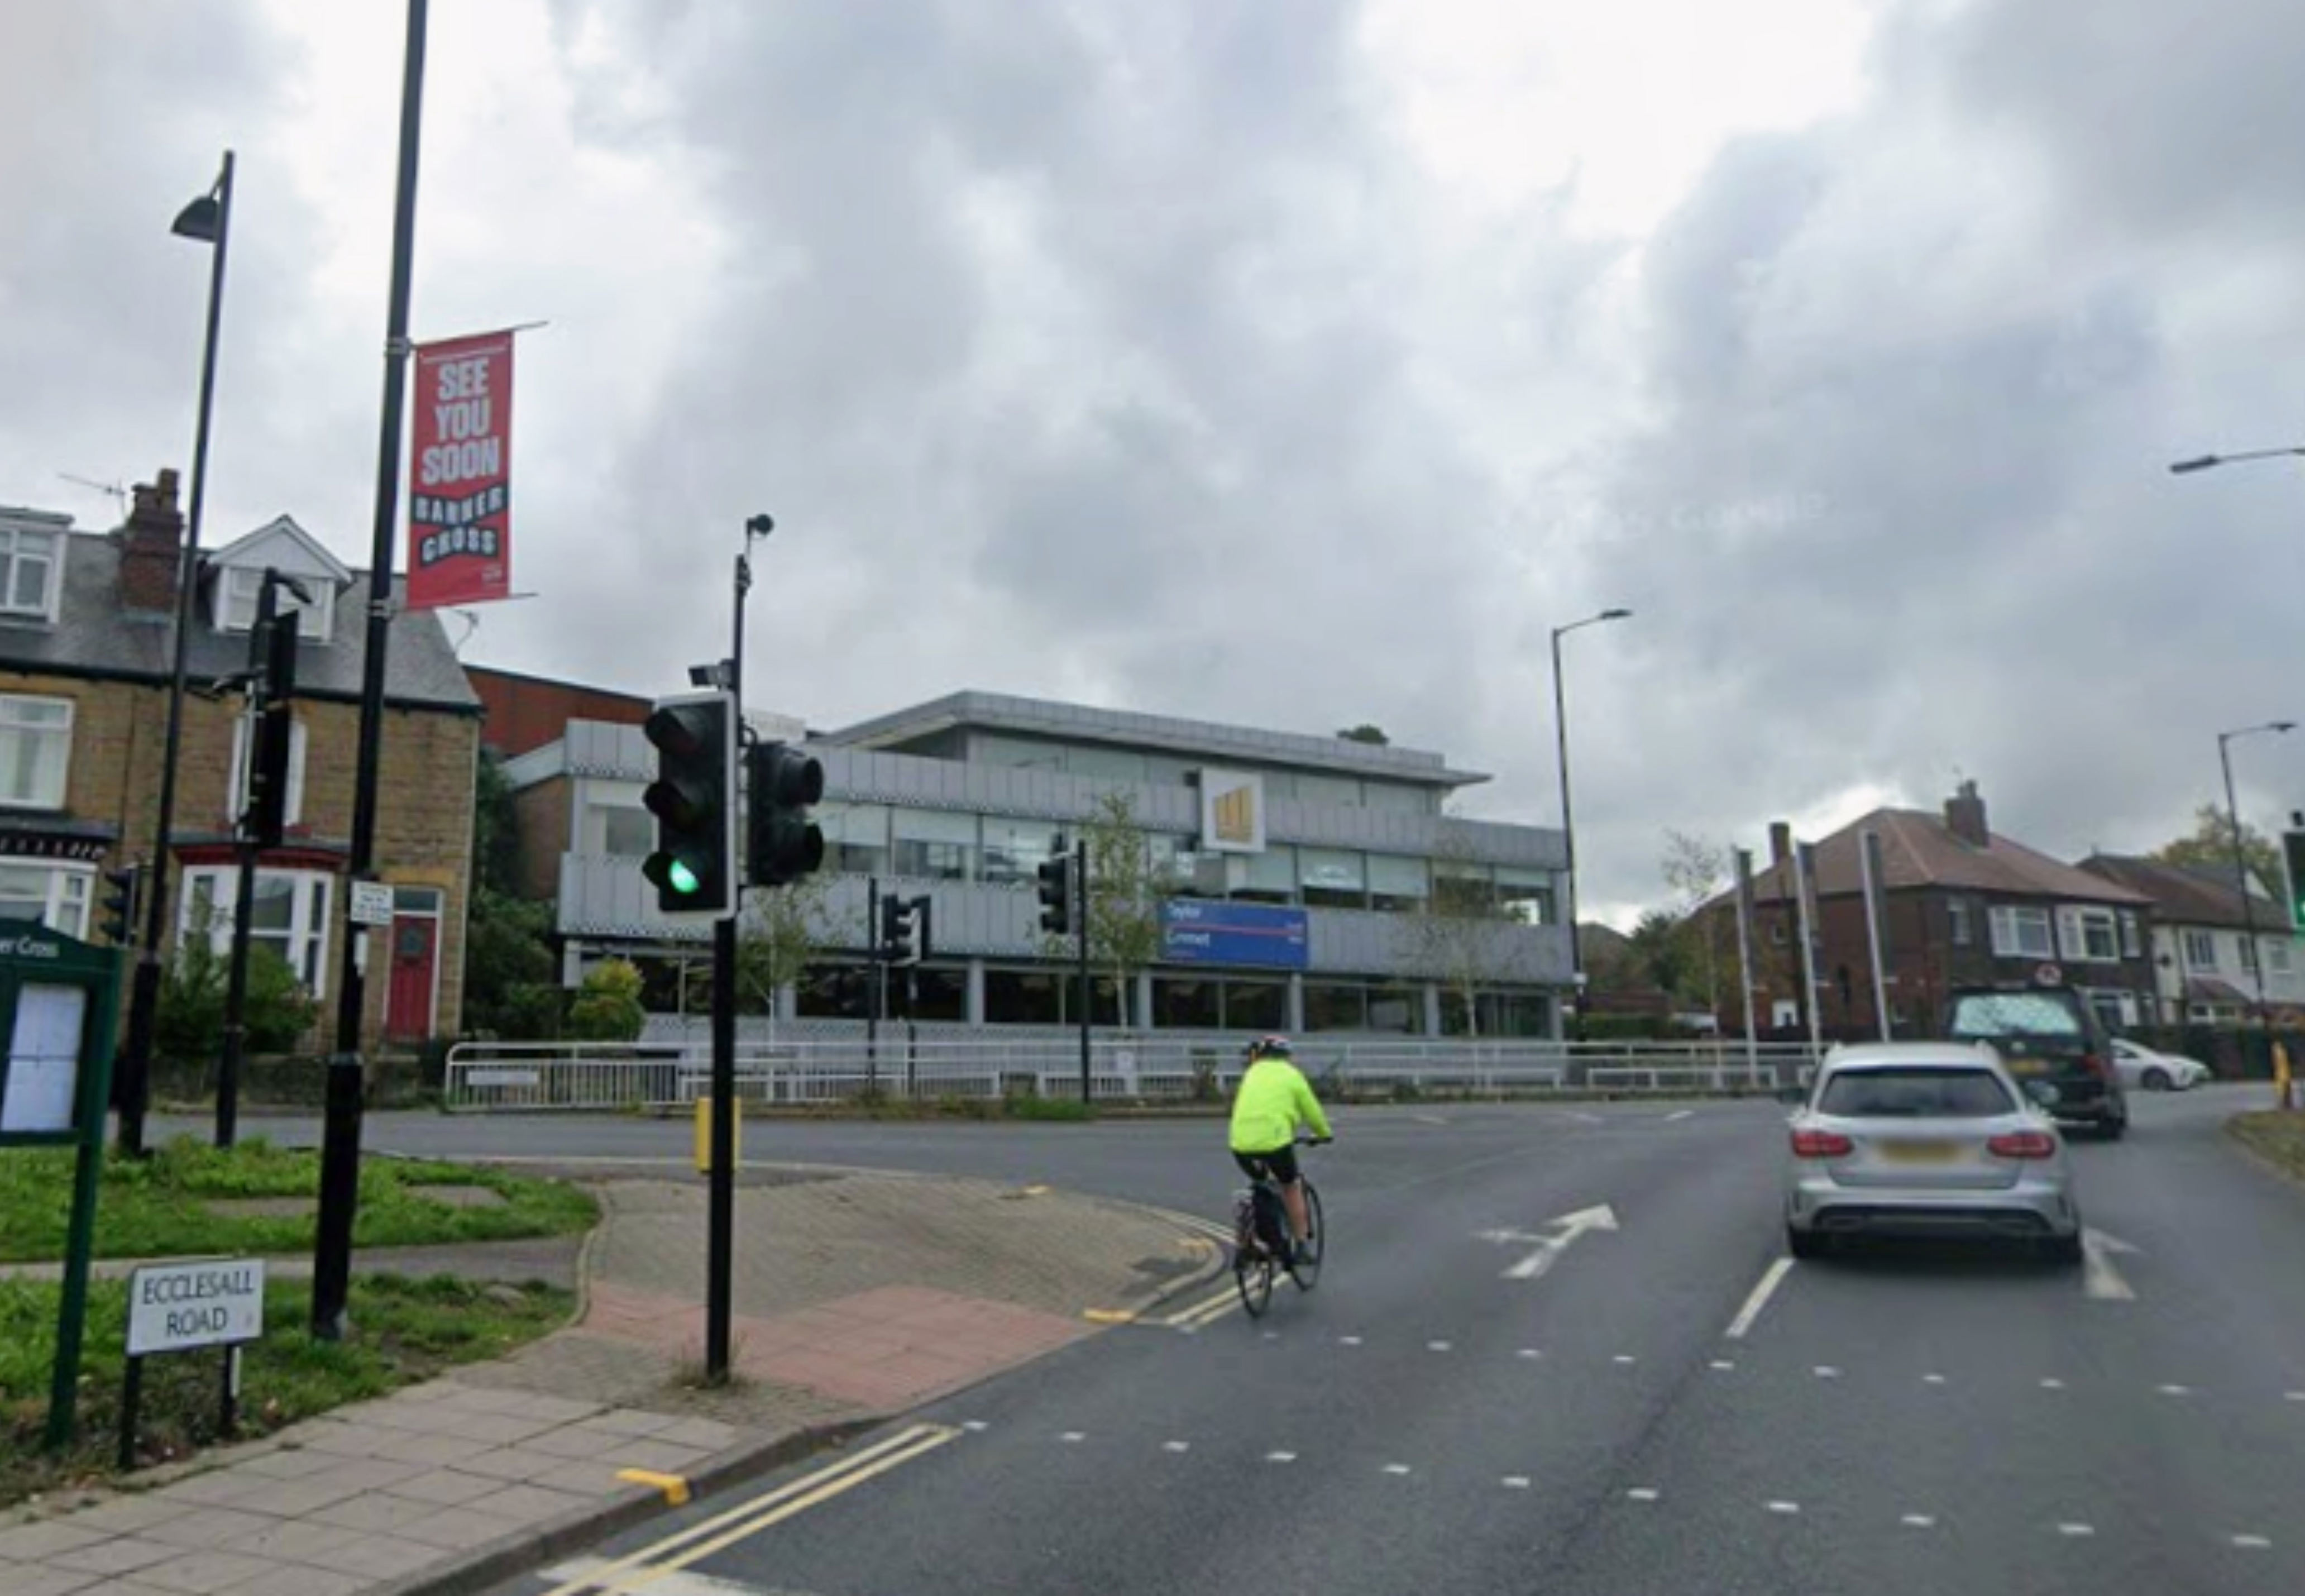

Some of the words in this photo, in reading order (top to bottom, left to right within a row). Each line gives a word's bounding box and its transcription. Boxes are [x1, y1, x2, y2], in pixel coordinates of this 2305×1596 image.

[438, 356, 490, 401] SEE
[435, 398, 491, 443] YOU
[422, 436, 501, 486] SOON
[143, 1271, 254, 1304] ECCLESALL
[167, 1307, 227, 1337] ROAD
